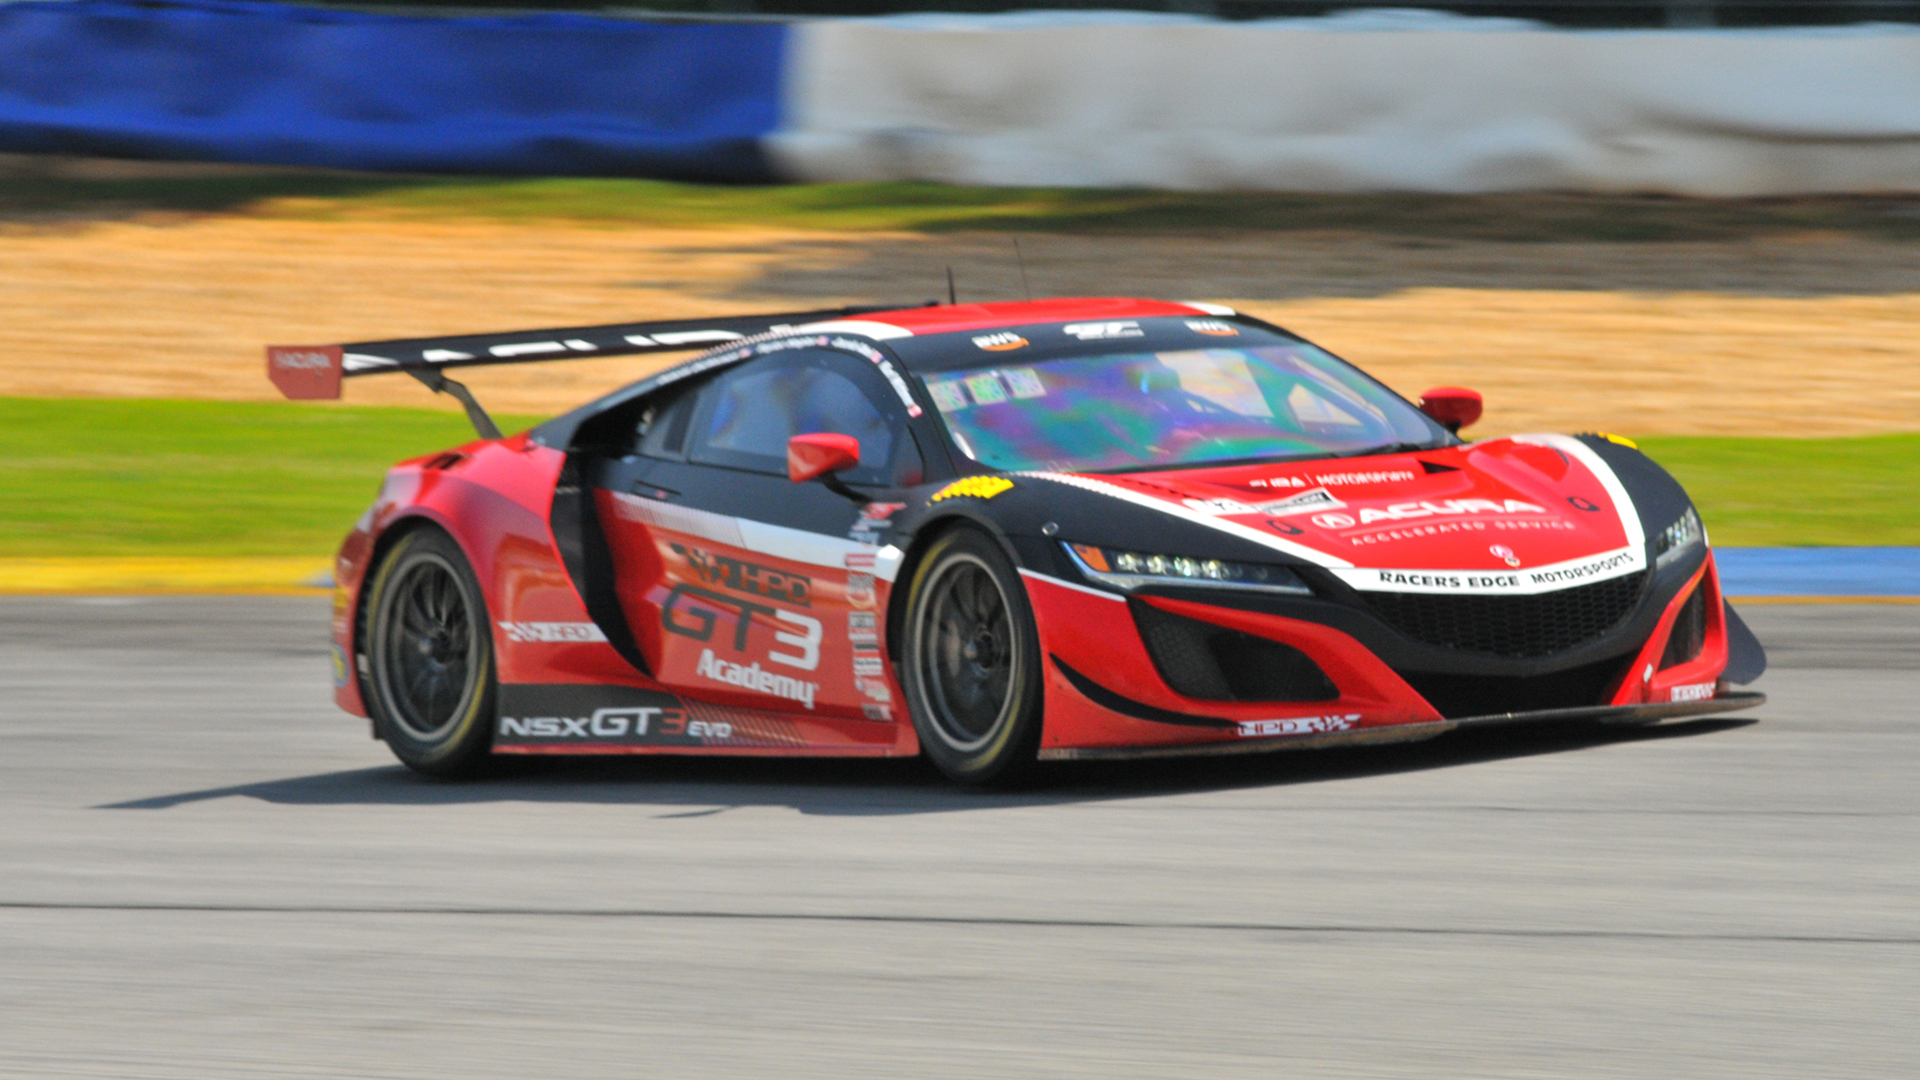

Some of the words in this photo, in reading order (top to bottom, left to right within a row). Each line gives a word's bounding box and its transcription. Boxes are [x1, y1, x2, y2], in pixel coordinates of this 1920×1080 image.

[1316, 471, 1414, 486] MOTORSPORTS
[1360, 499, 1547, 524] ACURA
[1351, 522, 1485, 547] ACCELERATED
[1499, 520, 1576, 531] SERVICE
[1379, 571, 1461, 588] RACERS
[1468, 576, 1521, 588] EDGE
[1530, 552, 1635, 585] MOTORSPORTS
[741, 564, 811, 604] HPD
[549, 625, 590, 640] HPD
[662, 583, 822, 671] GT3
[696, 648, 815, 710] Academy
[686, 720, 733, 739] EVO
